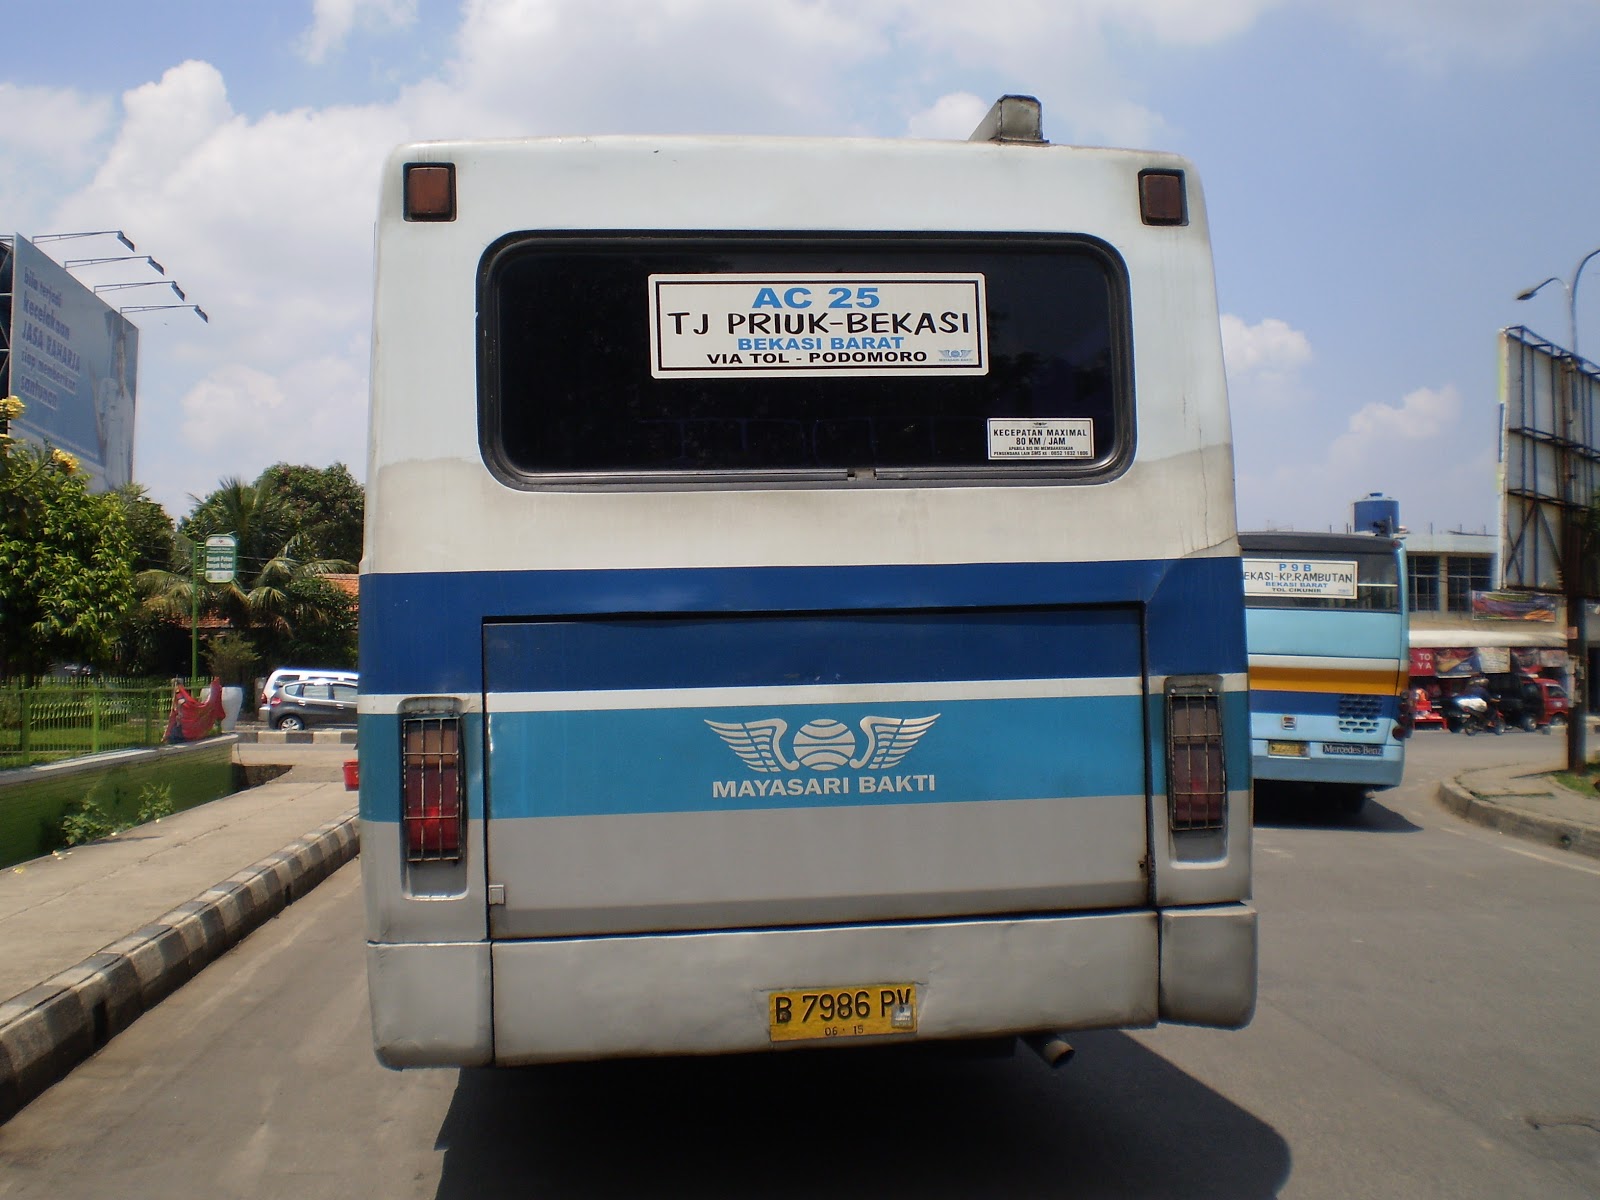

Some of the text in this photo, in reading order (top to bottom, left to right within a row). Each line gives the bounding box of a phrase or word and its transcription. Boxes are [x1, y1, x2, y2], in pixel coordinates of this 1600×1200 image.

[751, 287, 880, 309] AC 25
[23, 290, 70, 340] kecelakaan
[667, 312, 969, 335] TJ PRIUK-BEKASI
[22, 320, 81, 373] JASA RAHARJA
[737, 336, 905, 350] BEKASI BARAT
[706, 353, 742, 364] VIA
[750, 353, 790, 364] TOL
[809, 351, 928, 363] PODOMORO
[1016, 437, 1026, 445] 80
[1028, 437, 1041, 445] KM
[1048, 437, 1066, 445] JAM
[1279, 563, 1312, 572] P 9 B
[1243, 572, 1353, 583] EKASI-KP.RAMBUTAN
[1324, 744, 1361, 755] Mercedes
[712, 774, 936, 798] MAYASARI BAKTI
[775, 996, 793, 1024] B
[802, 990, 871, 1023] 7986
[824, 1024, 864, 1036] 06 15
